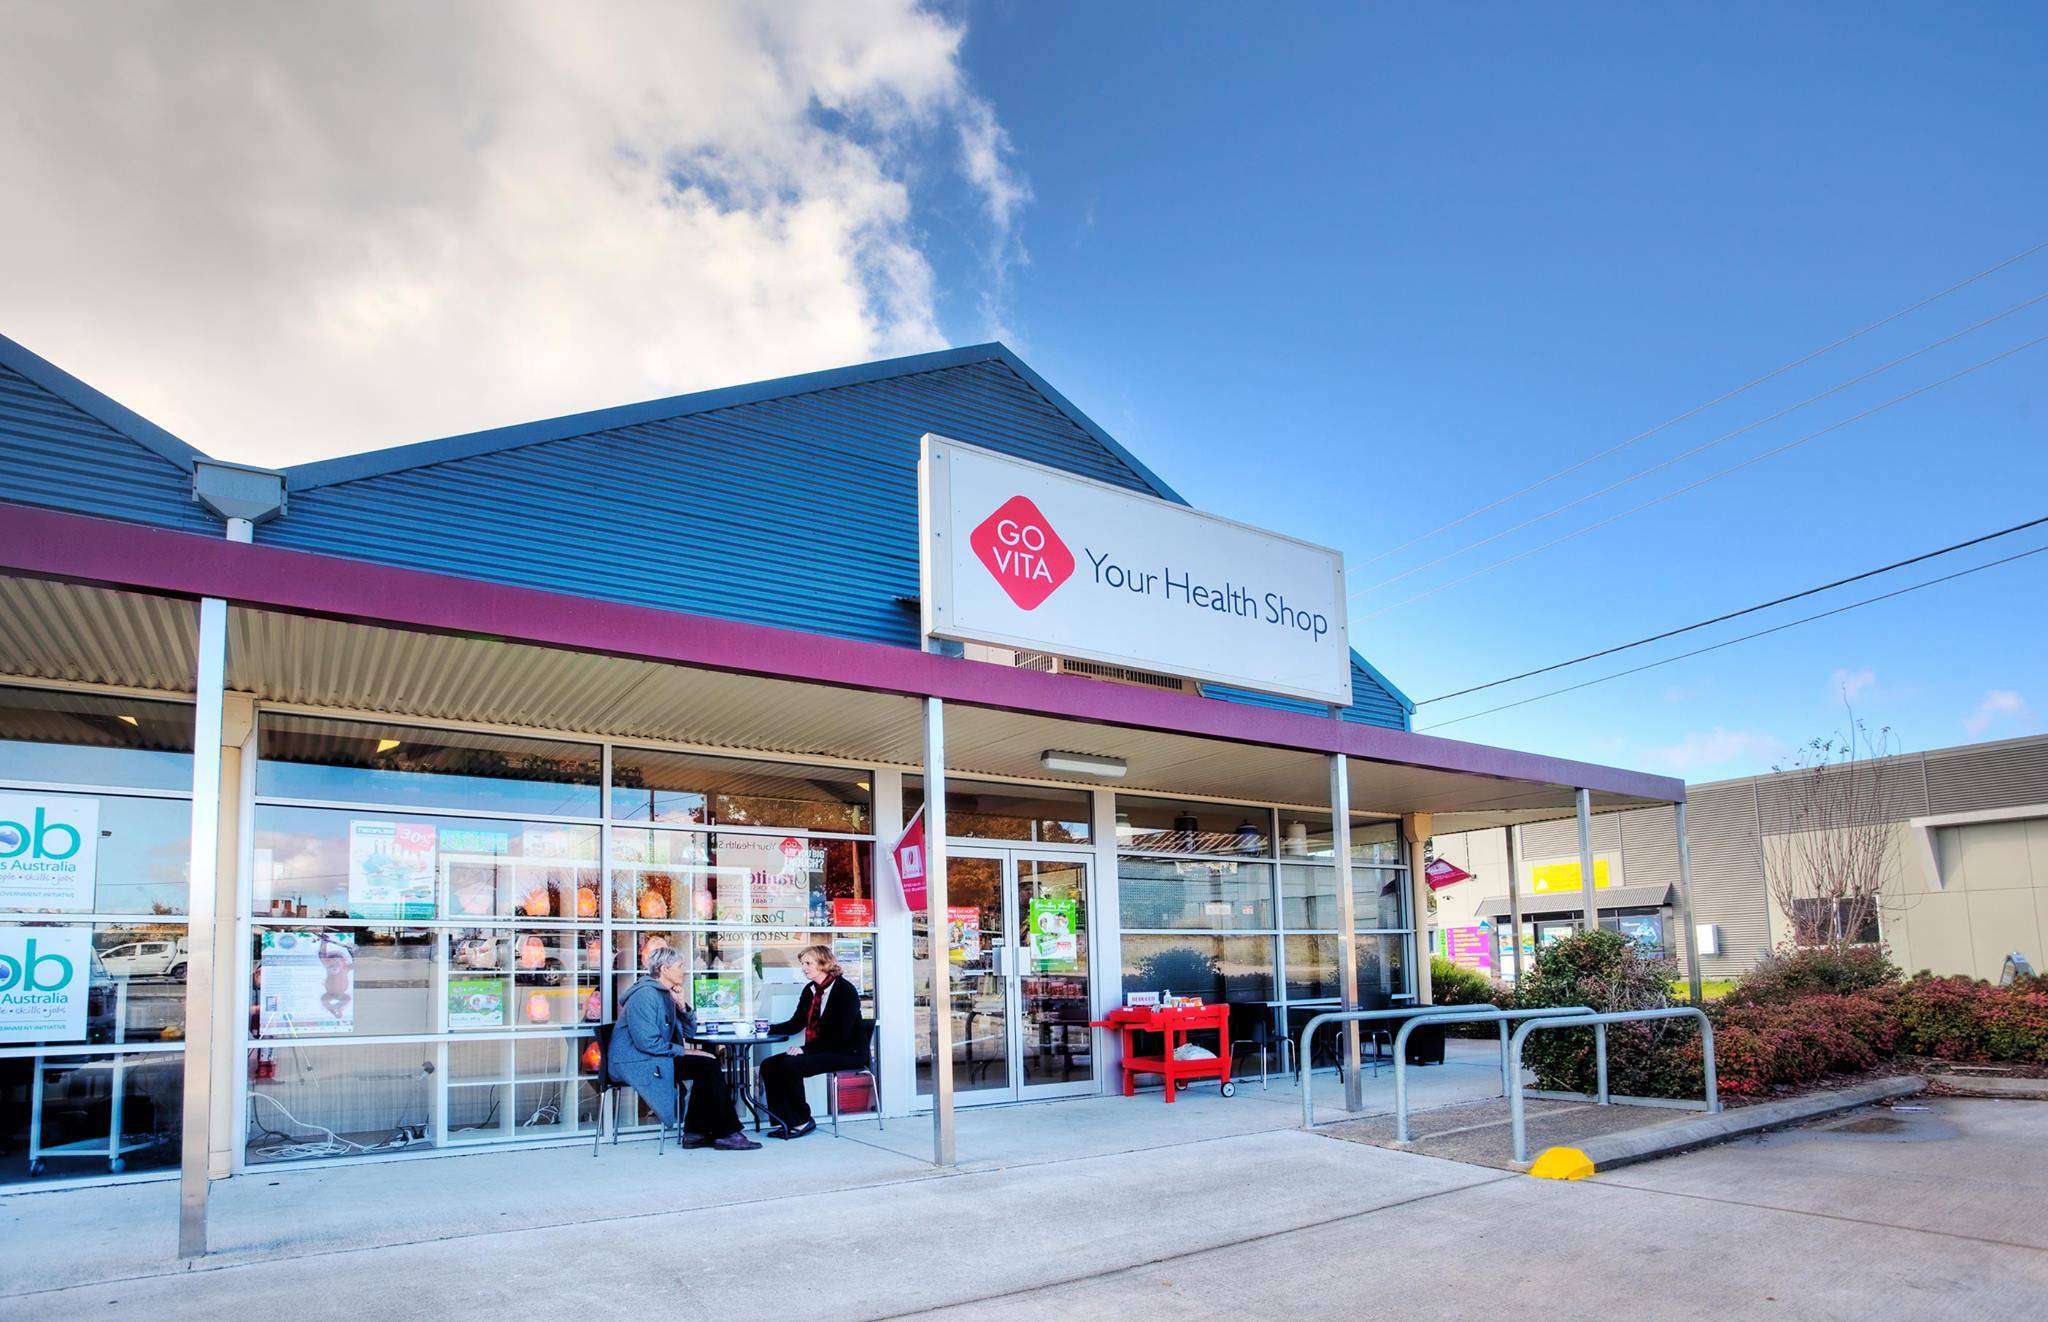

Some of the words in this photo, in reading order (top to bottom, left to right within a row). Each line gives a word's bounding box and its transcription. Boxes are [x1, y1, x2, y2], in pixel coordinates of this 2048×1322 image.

[997, 519, 1045, 551] GO
[992, 546, 1054, 584] VITA
[1084, 547, 1158, 596] Your
[1165, 566, 1257, 620] Health
[1265, 592, 1328, 643] Shop
[11, 859, 77, 872] Australia
[1, 993, 68, 1005] Australia
[44, 1006, 67, 1018] jobs
